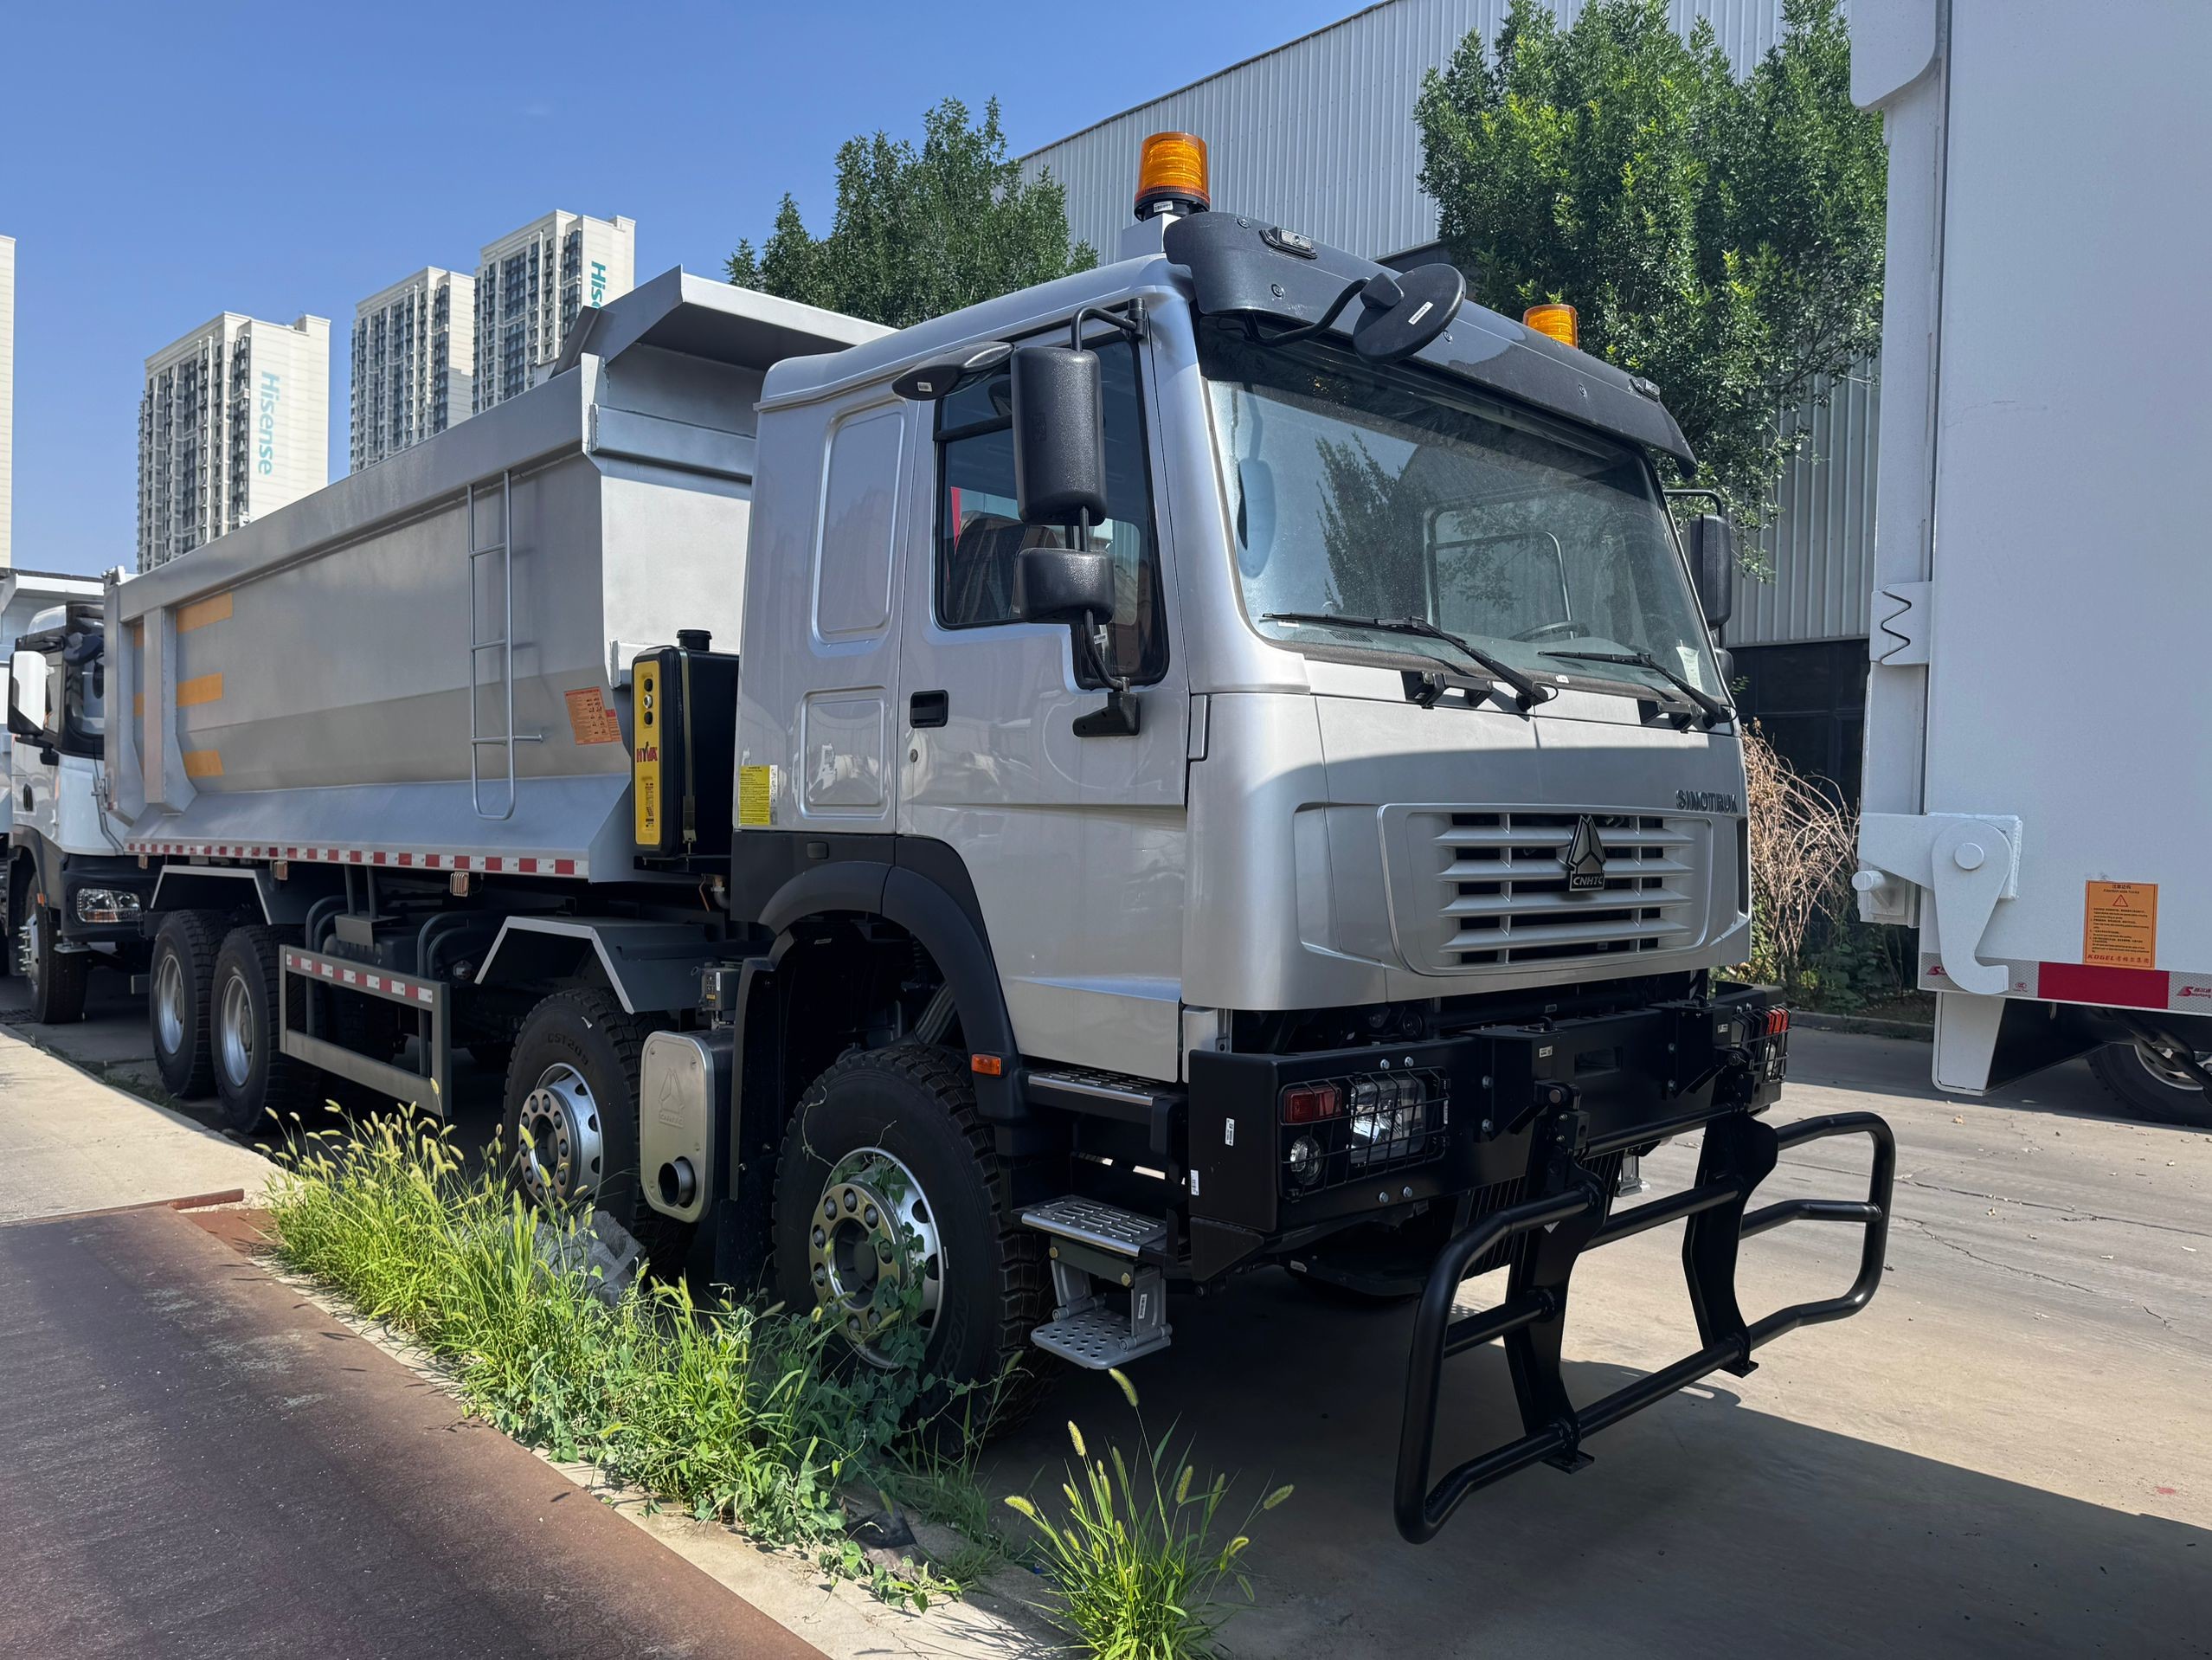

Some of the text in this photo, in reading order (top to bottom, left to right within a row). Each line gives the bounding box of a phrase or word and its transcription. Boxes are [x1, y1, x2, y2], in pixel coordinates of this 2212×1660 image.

[259, 370, 280, 475] Hisense
[637, 741, 658, 762] HYVA
[1675, 789, 1738, 813] SINOTRUK
[1572, 876, 1603, 885] CNHTC
